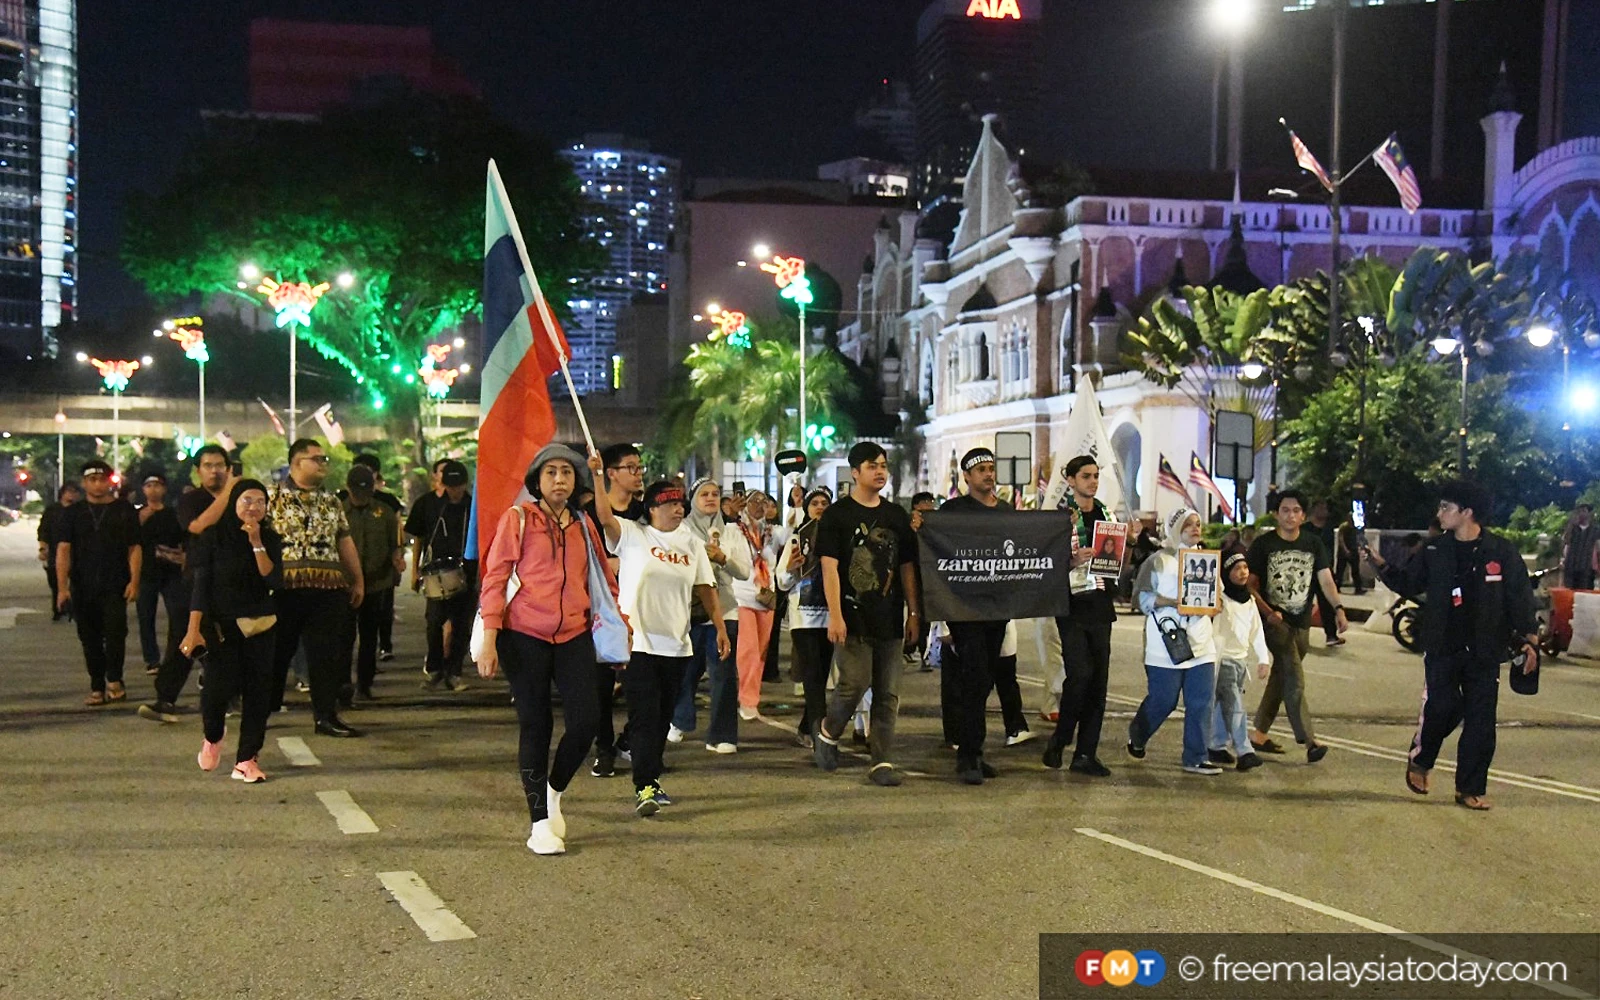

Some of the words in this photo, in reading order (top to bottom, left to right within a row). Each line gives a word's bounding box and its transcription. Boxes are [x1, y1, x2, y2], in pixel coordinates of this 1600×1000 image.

[966, 0, 1021, 20] AIA
[955, 548, 998, 557] JUSTICE
[1017, 547, 1038, 556] FOR
